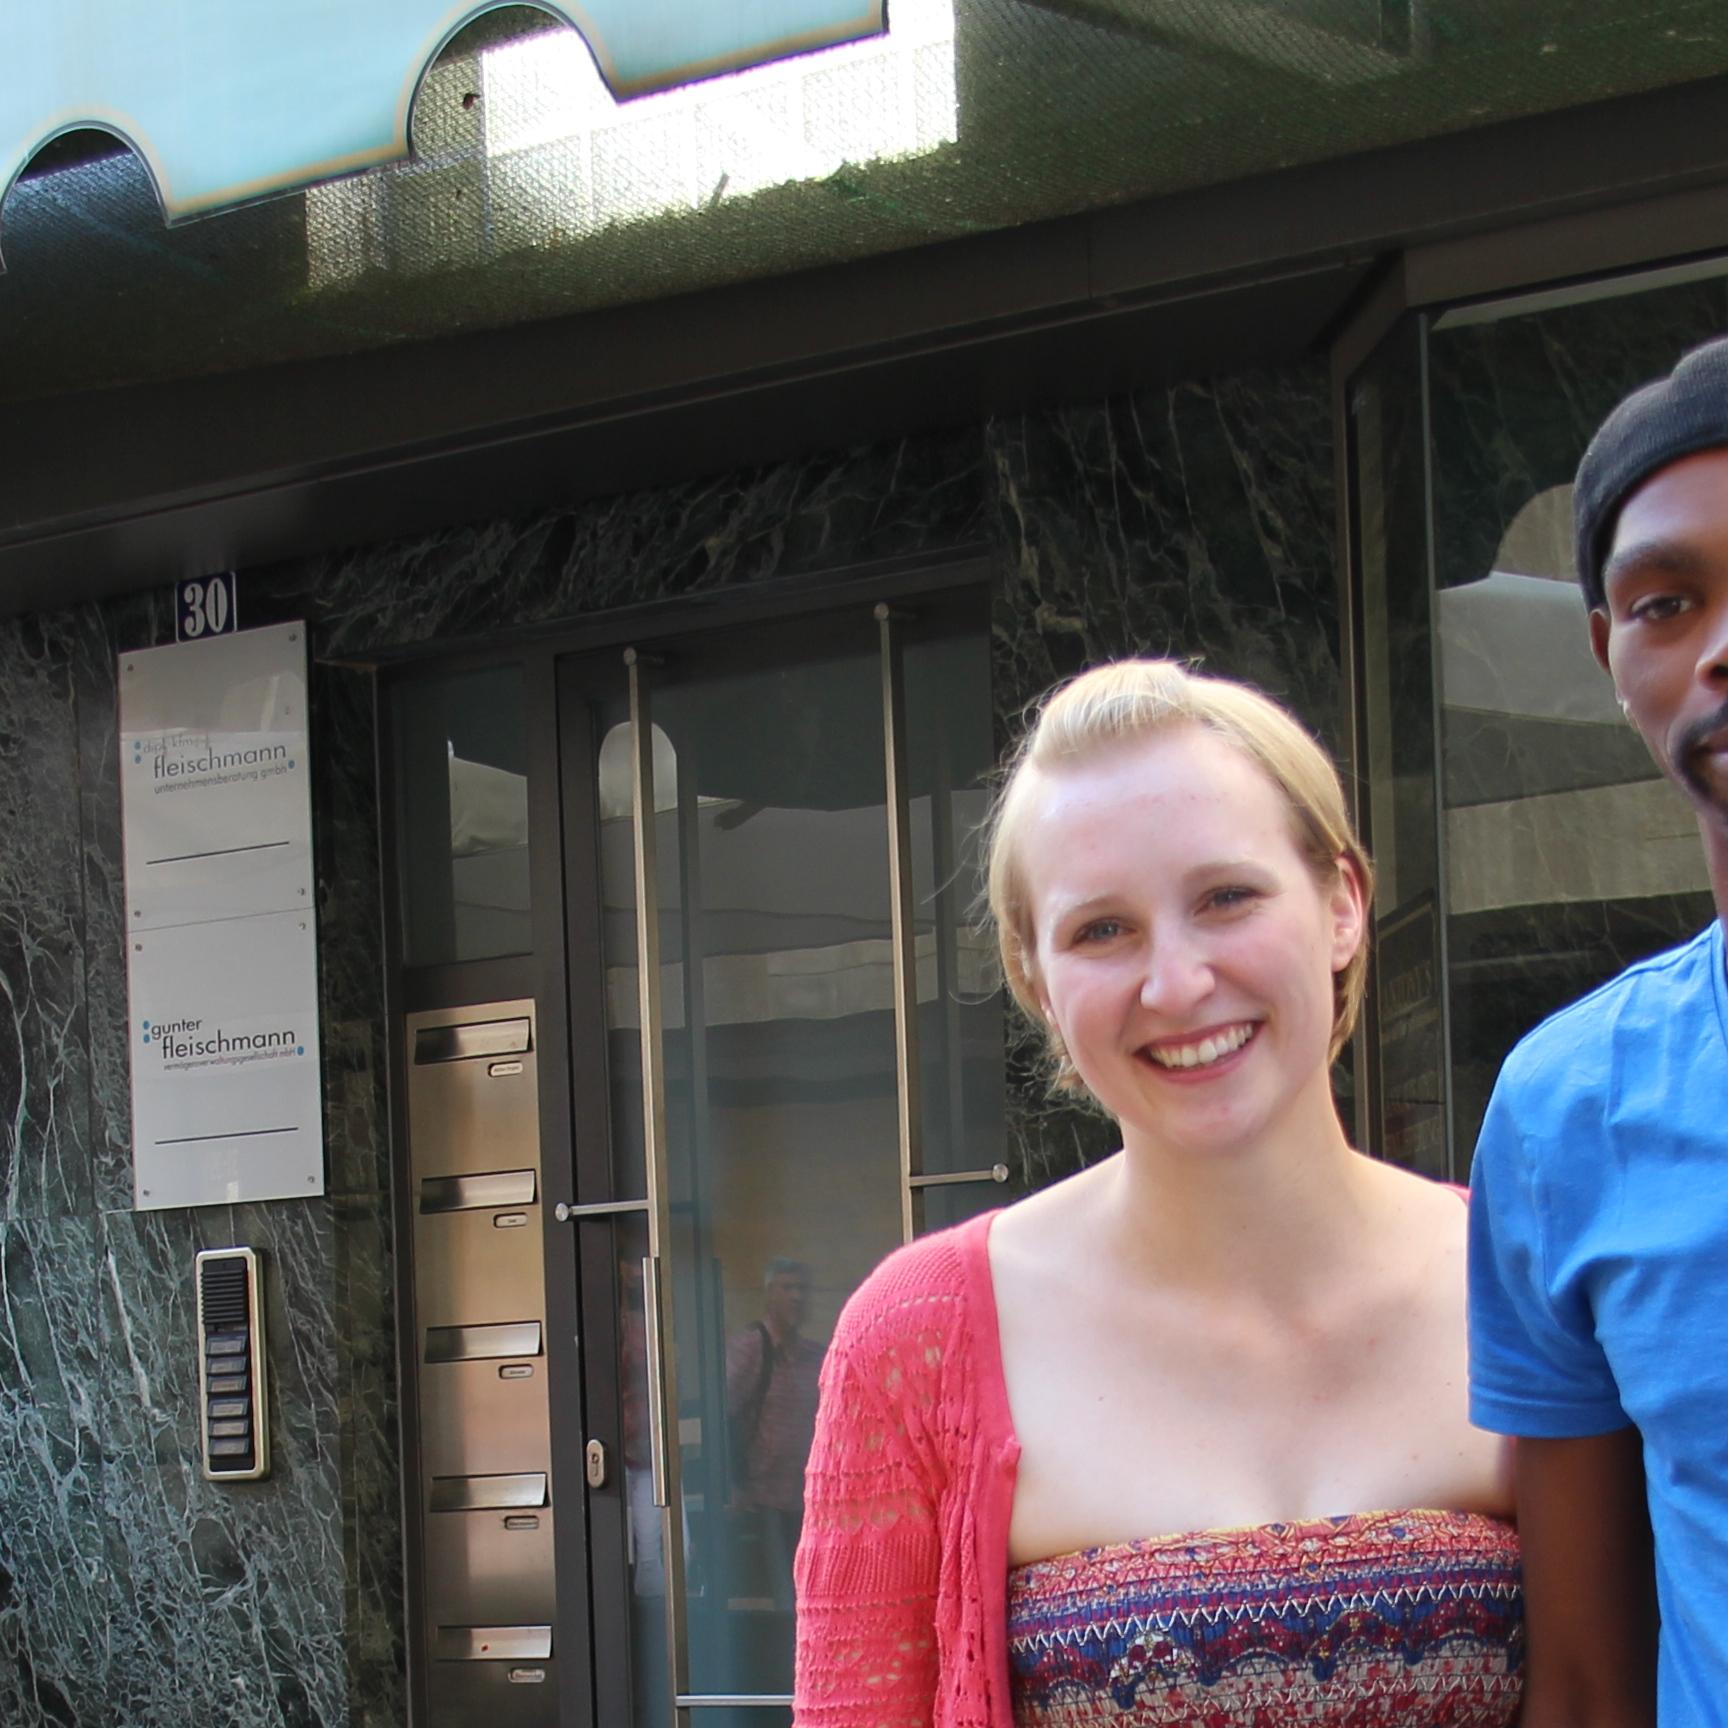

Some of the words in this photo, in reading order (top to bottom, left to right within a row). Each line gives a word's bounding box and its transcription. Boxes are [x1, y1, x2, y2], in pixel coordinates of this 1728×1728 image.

[184, 577, 228, 637] 30
[154, 745, 287, 779] fleischmann
[151, 1019, 202, 1041] gunter
[162, 1029, 295, 1059] fleischmann
